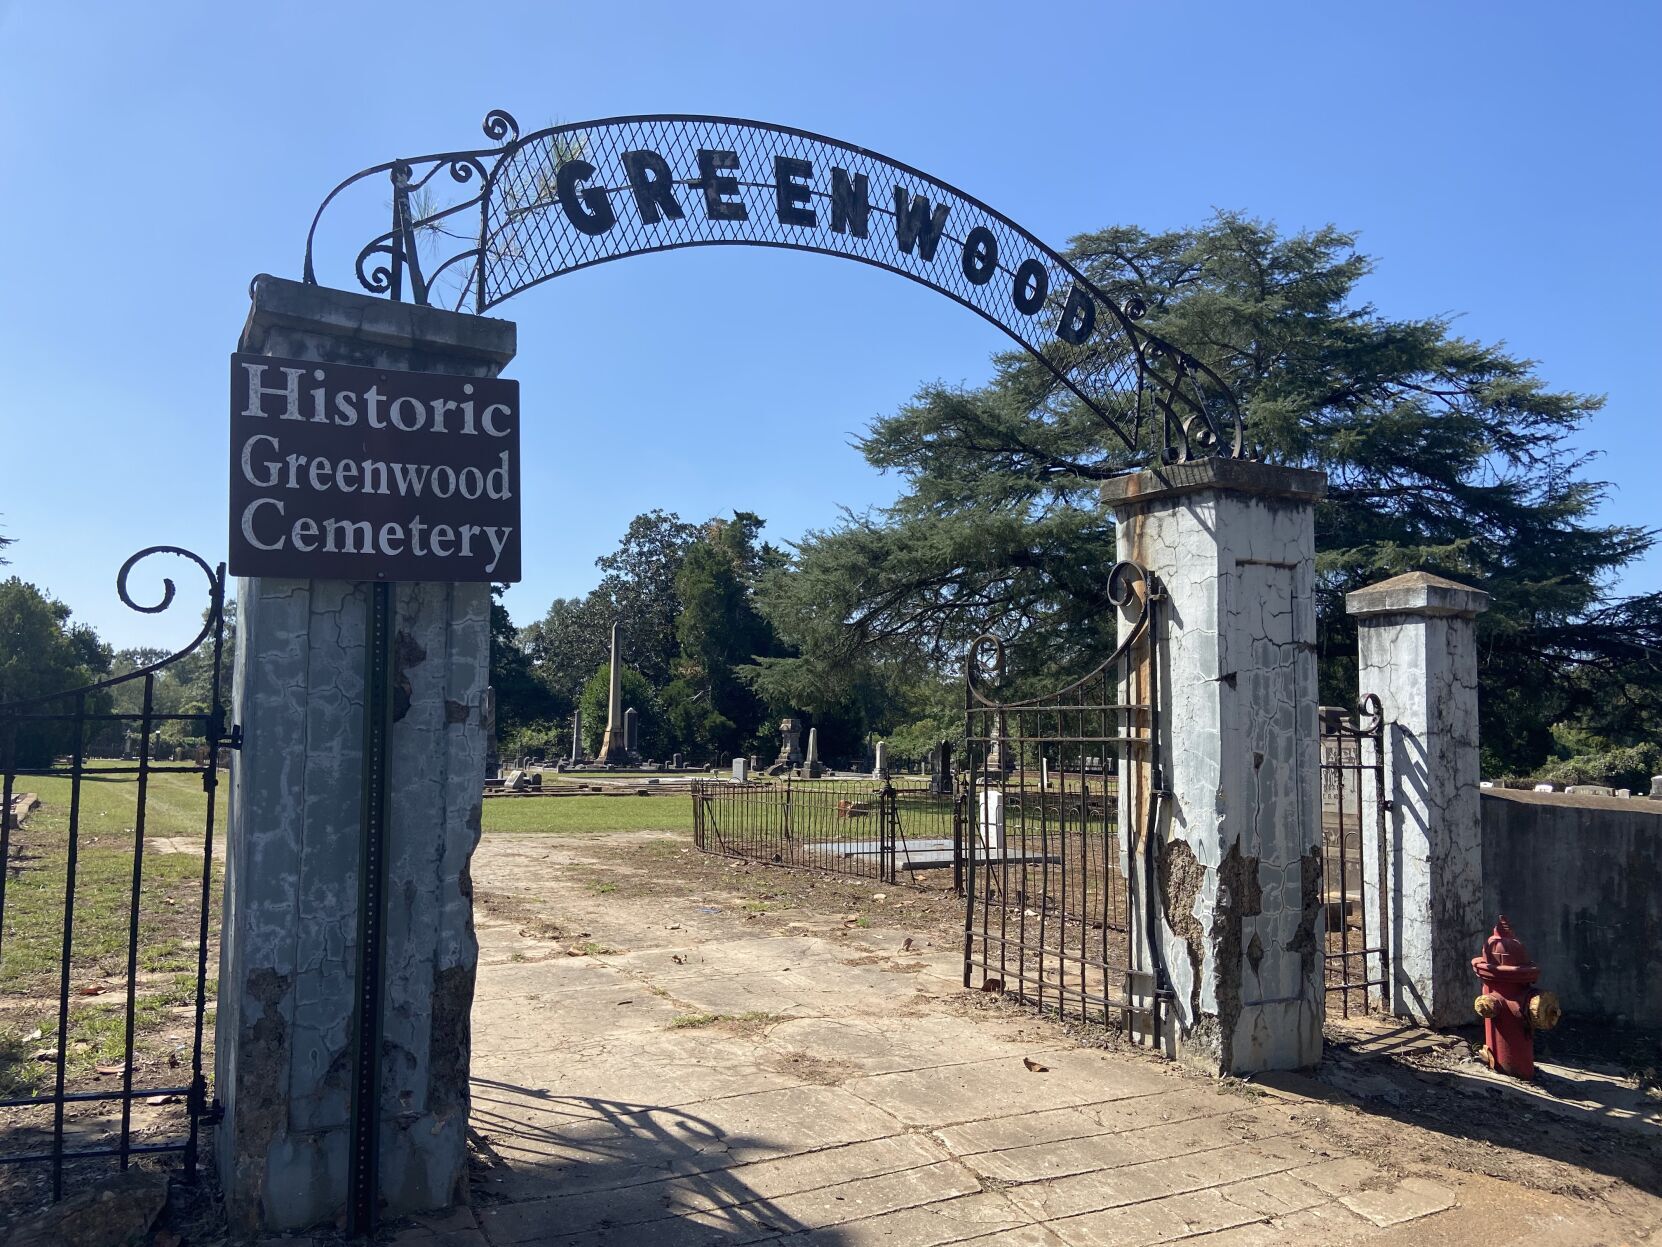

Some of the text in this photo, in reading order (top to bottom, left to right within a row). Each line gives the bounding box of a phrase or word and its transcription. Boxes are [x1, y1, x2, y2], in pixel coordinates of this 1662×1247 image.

[556, 149, 1097, 346] GREENWOOD
[241, 362, 512, 437] Historic
[241, 434, 513, 500] Greenwood
[241, 498, 513, 573] Cemetery
